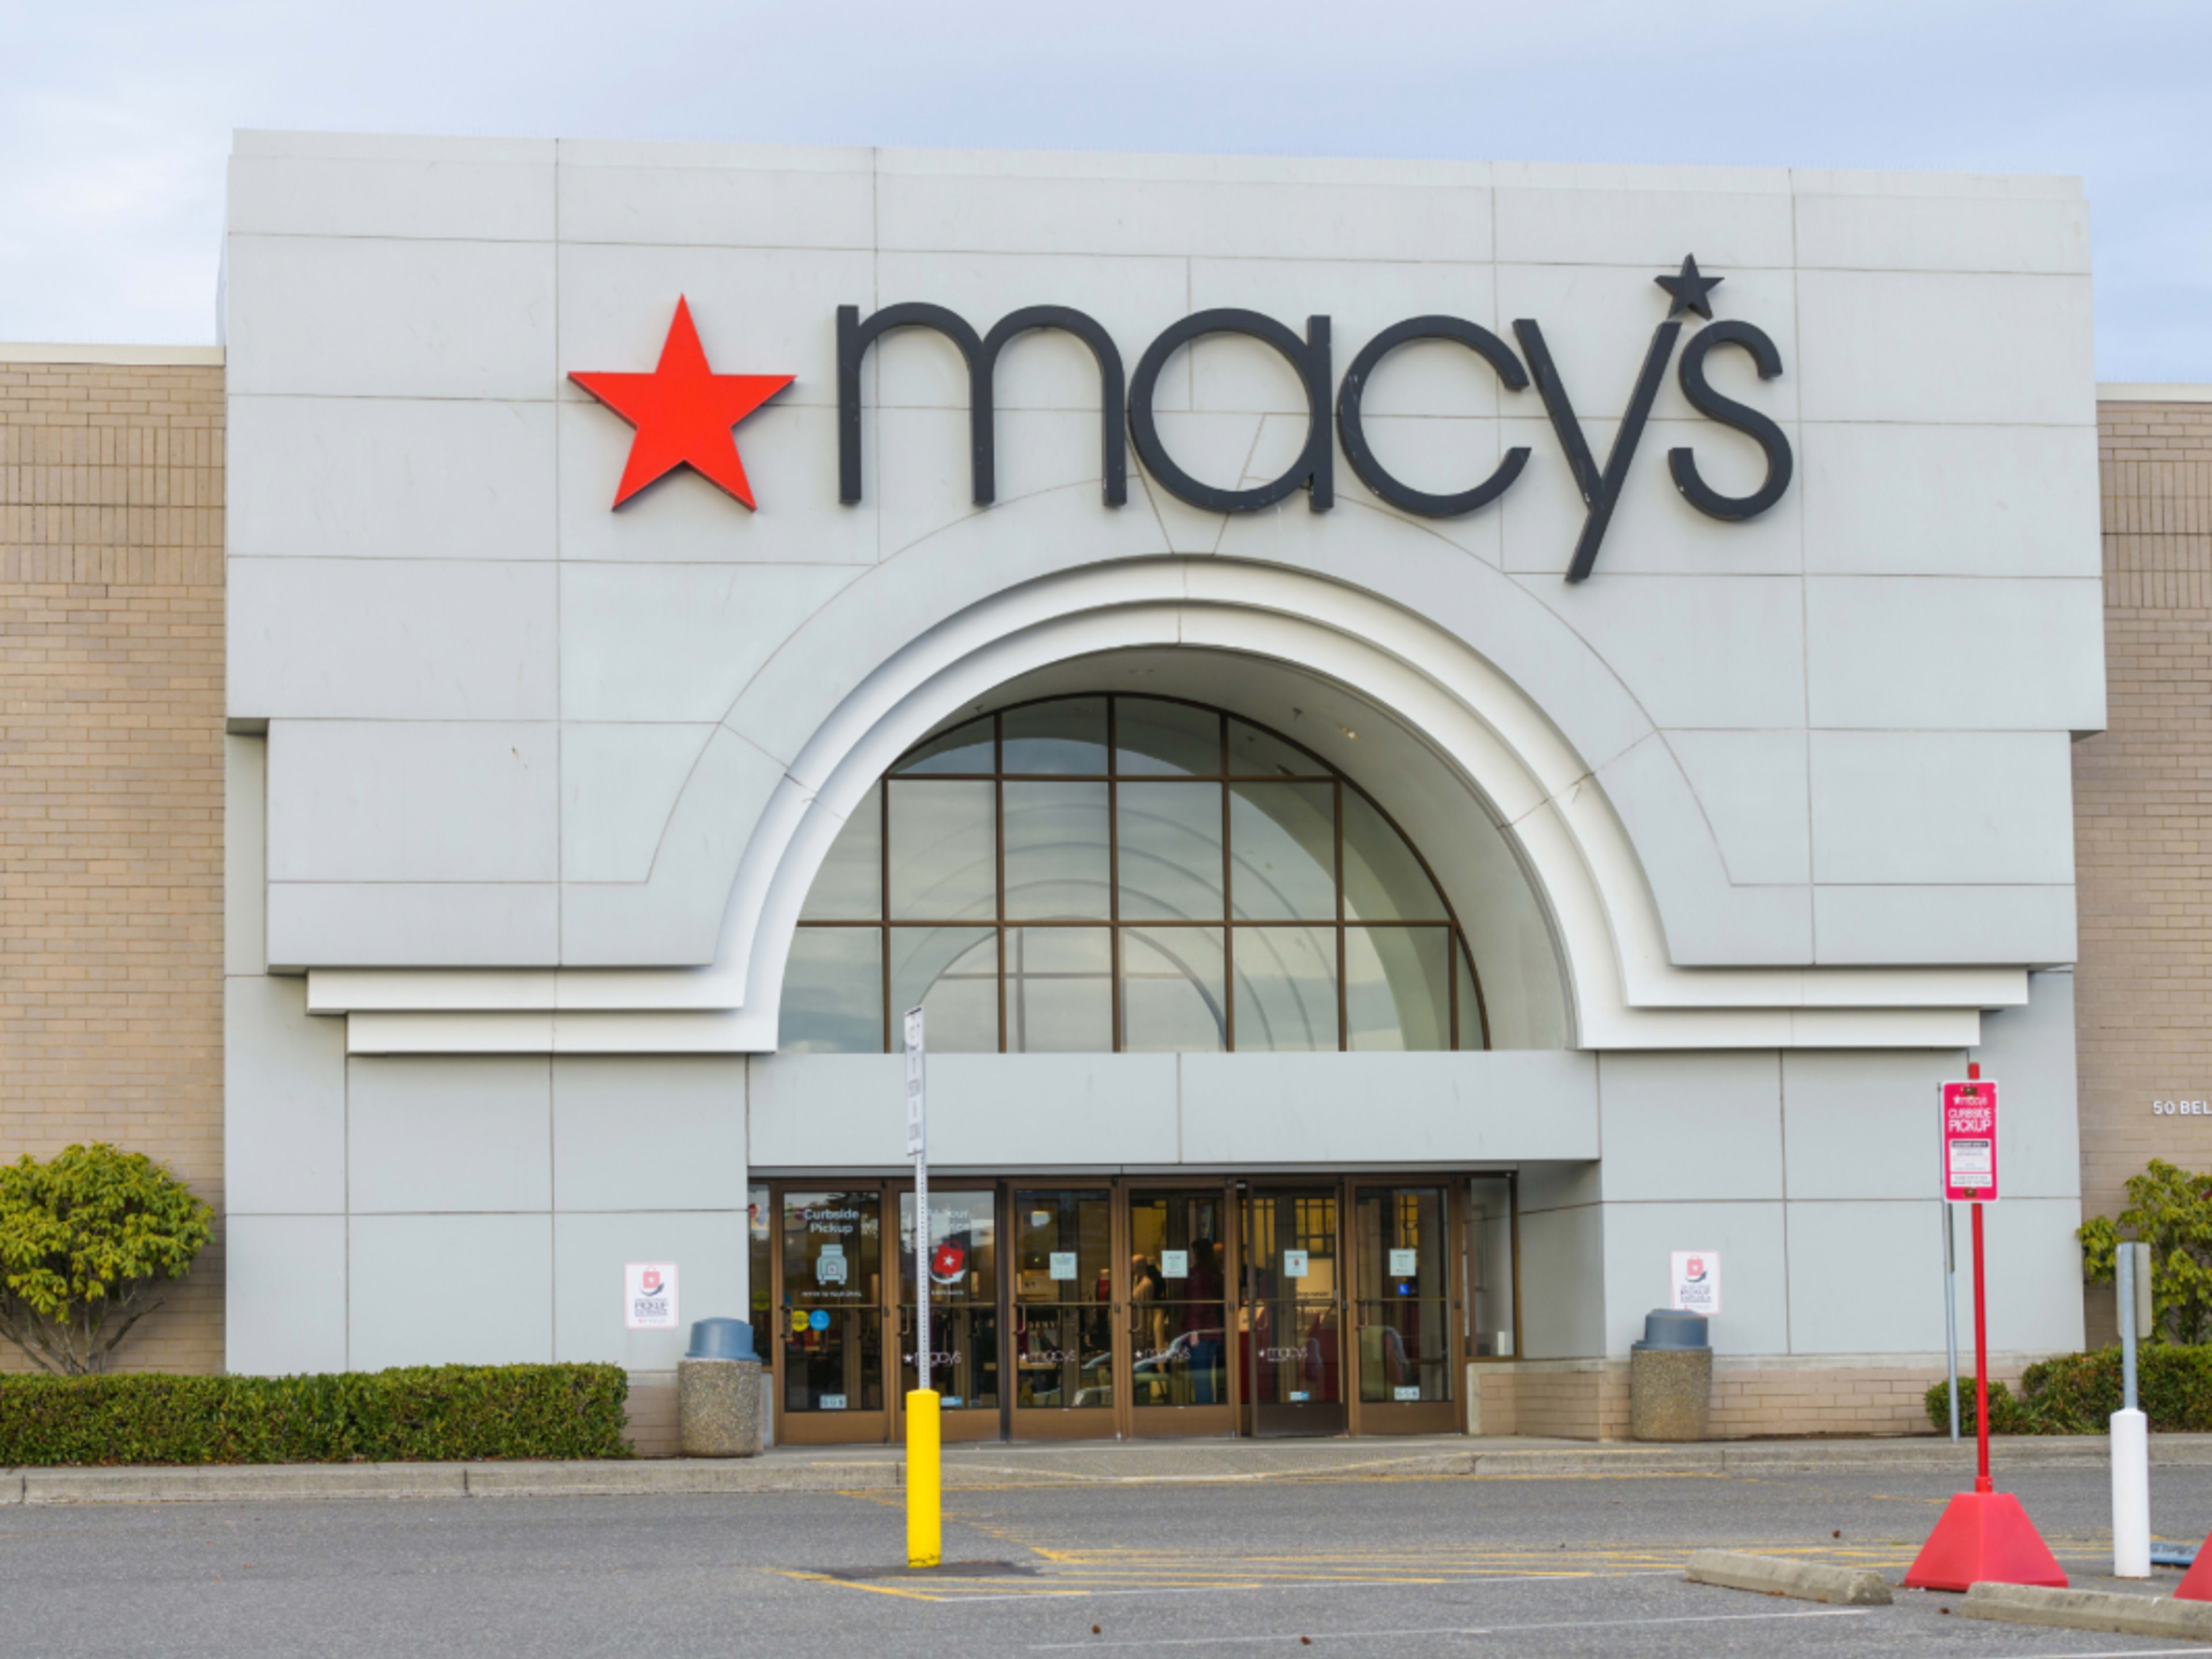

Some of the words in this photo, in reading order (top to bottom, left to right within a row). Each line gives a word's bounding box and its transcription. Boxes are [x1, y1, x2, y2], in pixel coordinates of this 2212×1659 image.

[836, 253, 1793, 583] macy's
[1948, 1108, 1991, 1119] CURBSIDE
[2152, 1100, 2176, 1115] 50
[2180, 1100, 2212, 1115] BEL
[1948, 1120, 1992, 1132] PICKUP
[804, 1207, 859, 1220] Curbside
[810, 1222, 854, 1236] Pickup
[915, 1350, 962, 1366] acy's
